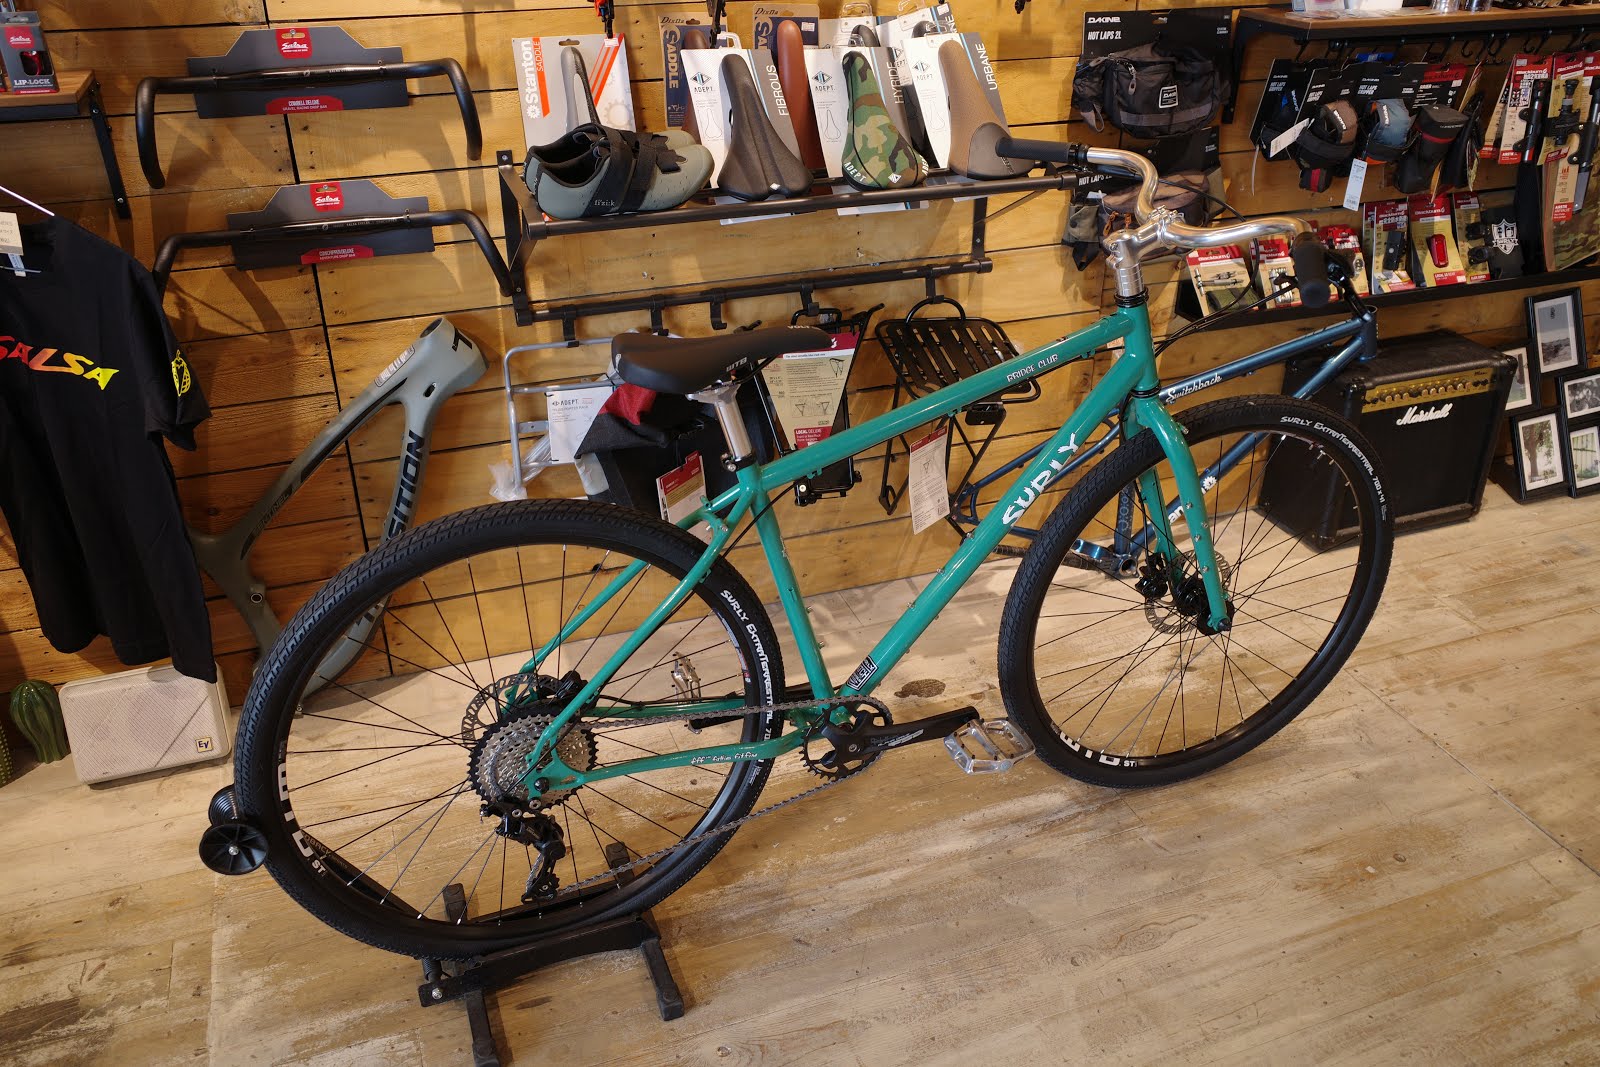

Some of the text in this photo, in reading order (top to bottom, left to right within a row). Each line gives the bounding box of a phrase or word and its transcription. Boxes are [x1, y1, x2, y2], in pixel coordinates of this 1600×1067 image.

[281, 42, 308, 50] Salsa
[1088, 31, 1100, 40] HOT
[1100, 31, 1114, 40] LAPS
[520, 40, 538, 104] Stanton
[534, 41, 544, 72] SADDLE
[663, 29, 680, 89] SADDLE
[975, 43, 998, 91] URBANE
[766, 64, 789, 116] FIBROUS
[844, 161, 867, 182] ADEPT
[315, 195, 340, 203] Salsa
[1006, 353, 1058, 383] BRIDGE CLUB
[1166, 373, 1223, 404] Switchback
[1280, 416, 1313, 427] SURLY
[1396, 402, 1453, 426] Marshall
[387, 429, 425, 541] SITION
[1001, 432, 1080, 526] SURLY
[720, 589, 750, 622] SURLY
